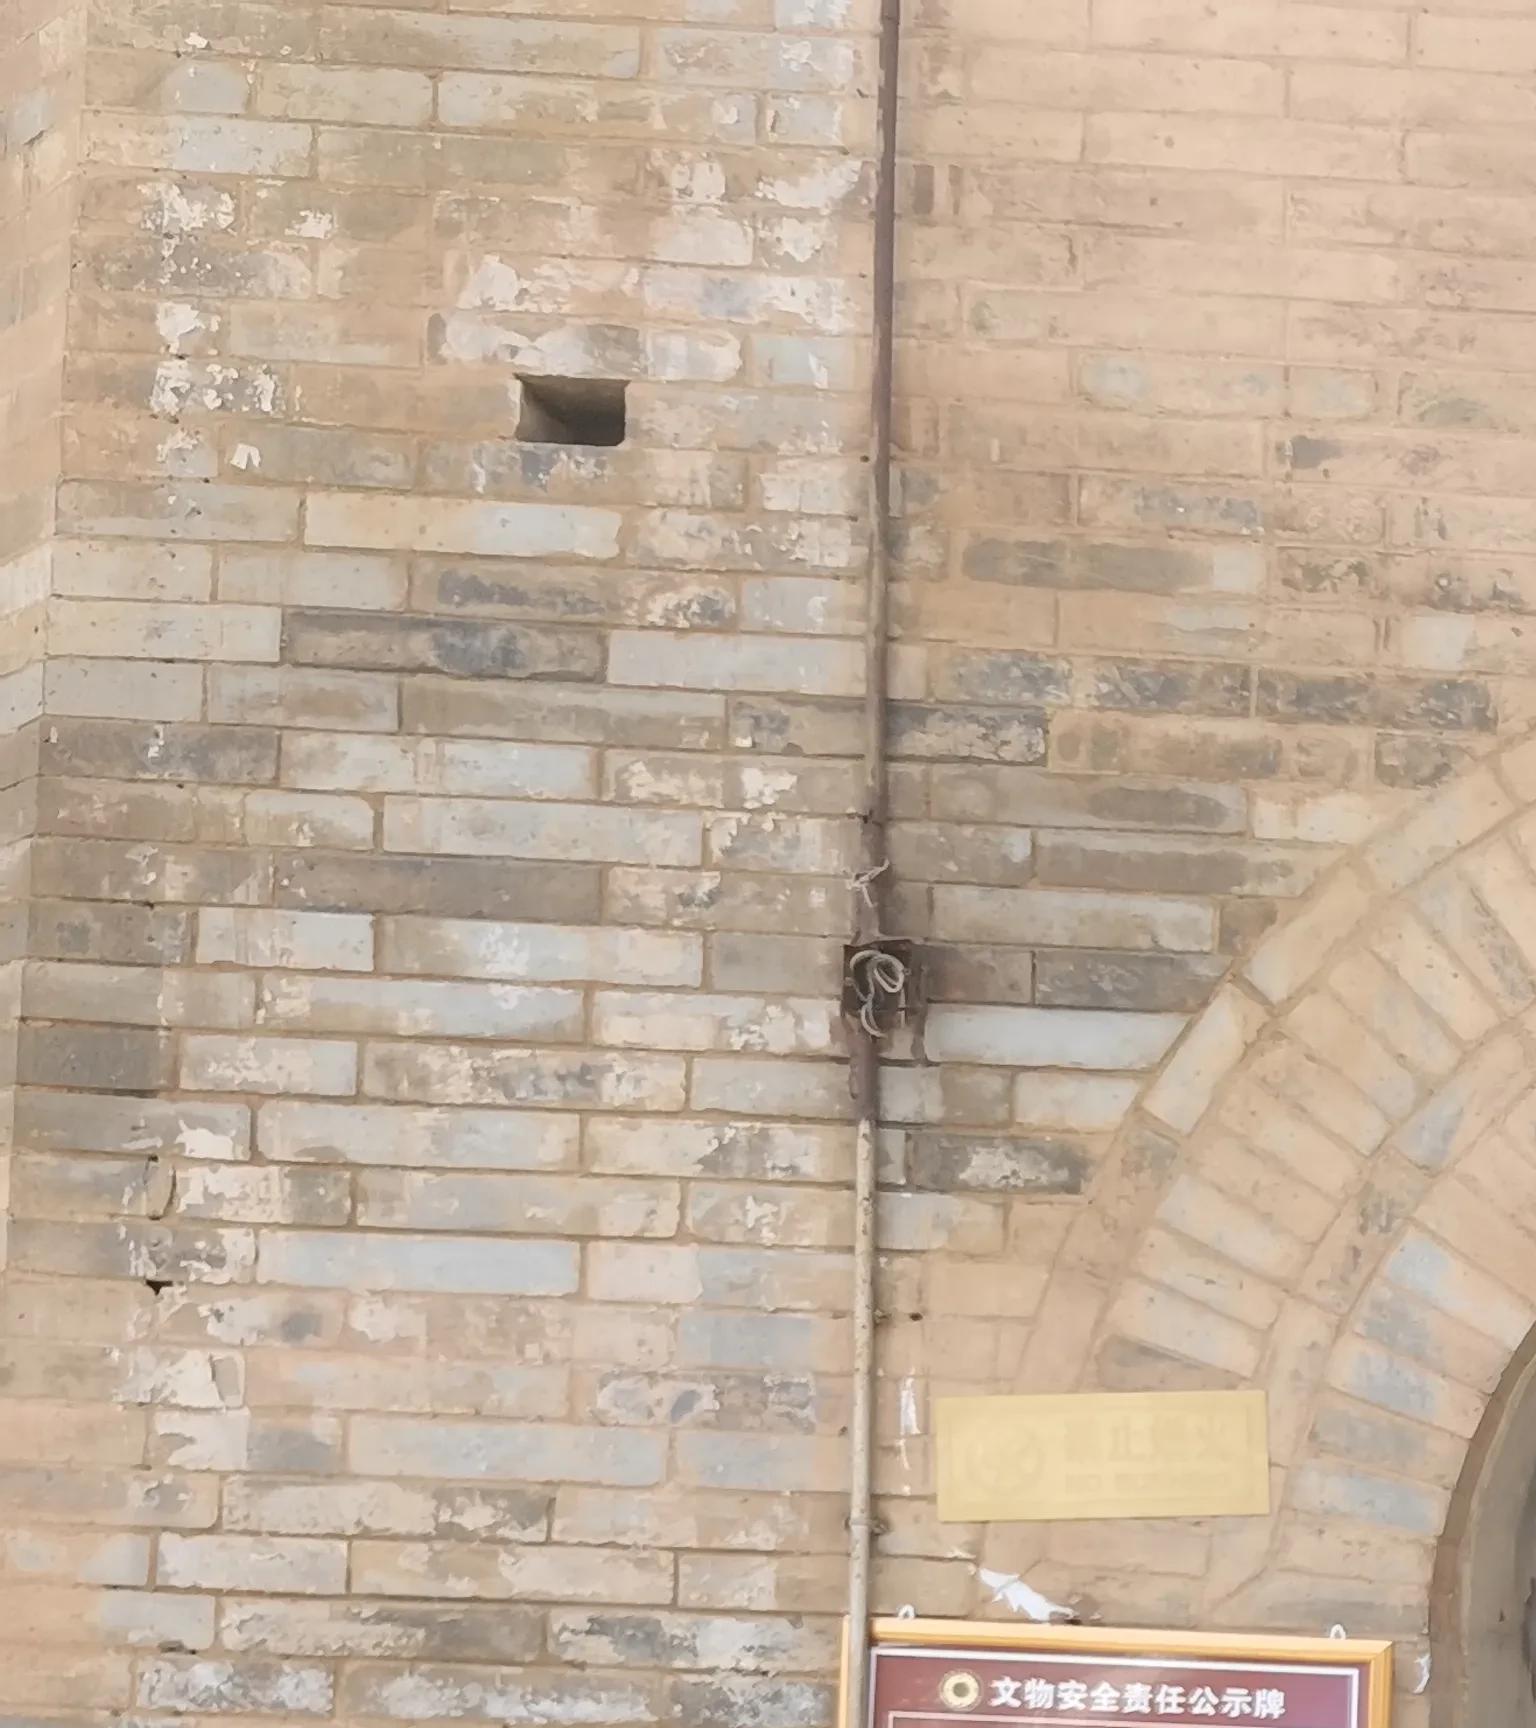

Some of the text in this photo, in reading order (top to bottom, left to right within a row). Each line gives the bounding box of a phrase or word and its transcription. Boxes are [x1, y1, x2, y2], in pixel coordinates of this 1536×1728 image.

[990, 1676, 1287, 1720] 文物安全责任公示牌
